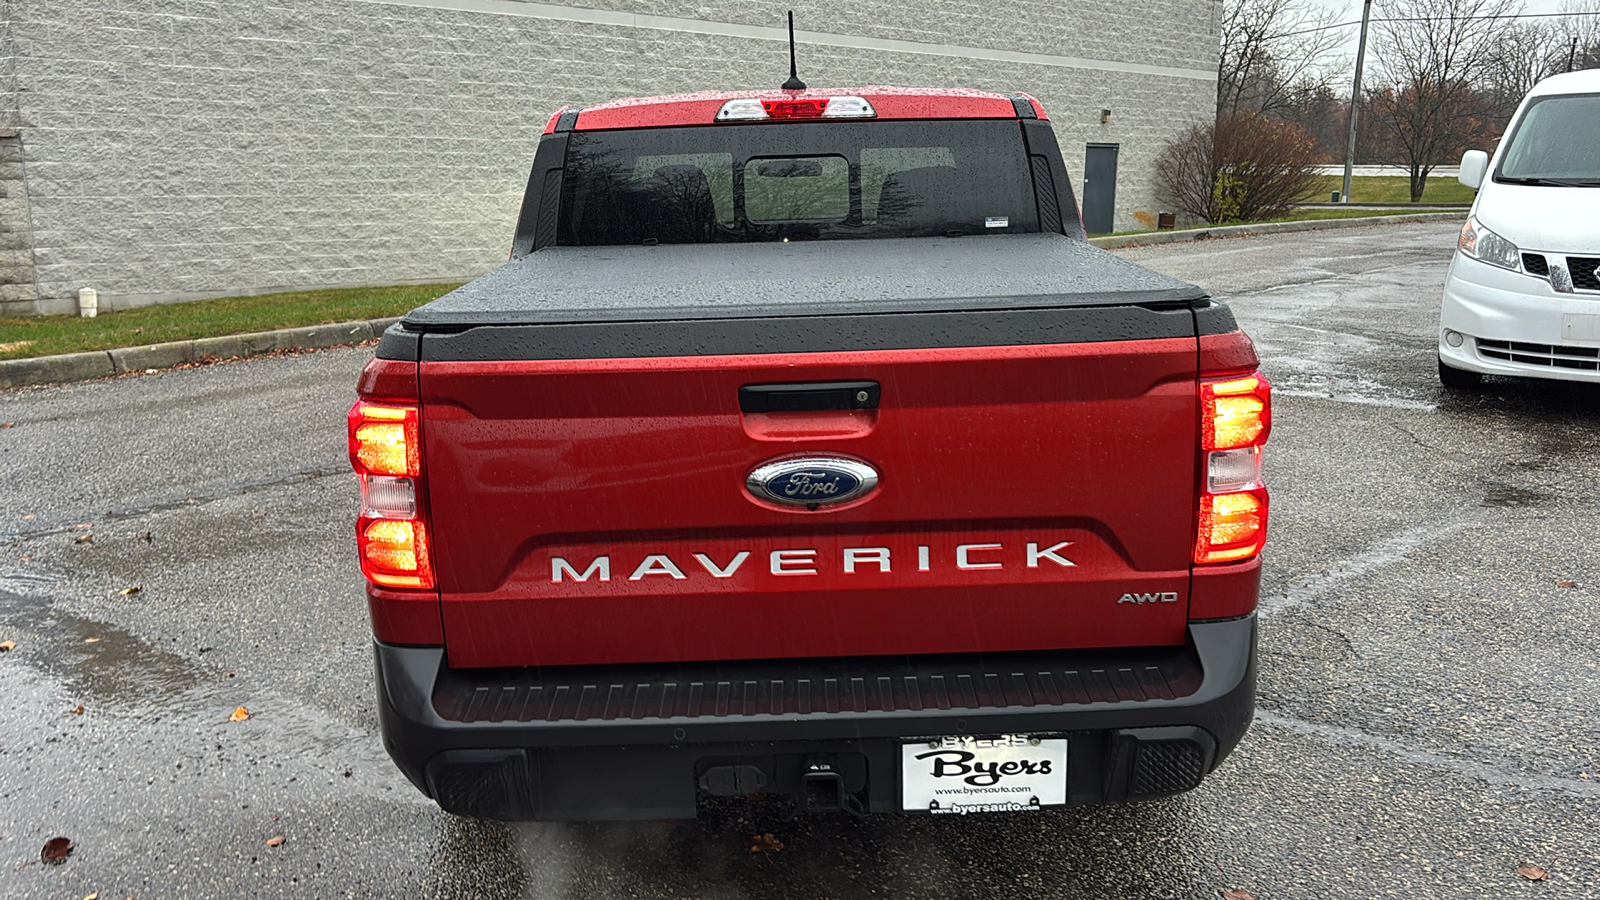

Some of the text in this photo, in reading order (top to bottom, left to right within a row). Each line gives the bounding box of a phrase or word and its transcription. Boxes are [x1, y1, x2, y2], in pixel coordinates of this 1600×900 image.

[784, 472, 840, 496] Ford
[551, 541, 1077, 583] MAVERICK
[1117, 592, 1178, 604] AWD
[914, 750, 1052, 786] Byers
[934, 785, 1032, 796] www.byersauto.com
[930, 801, 1041, 816] www.byersauto.com
